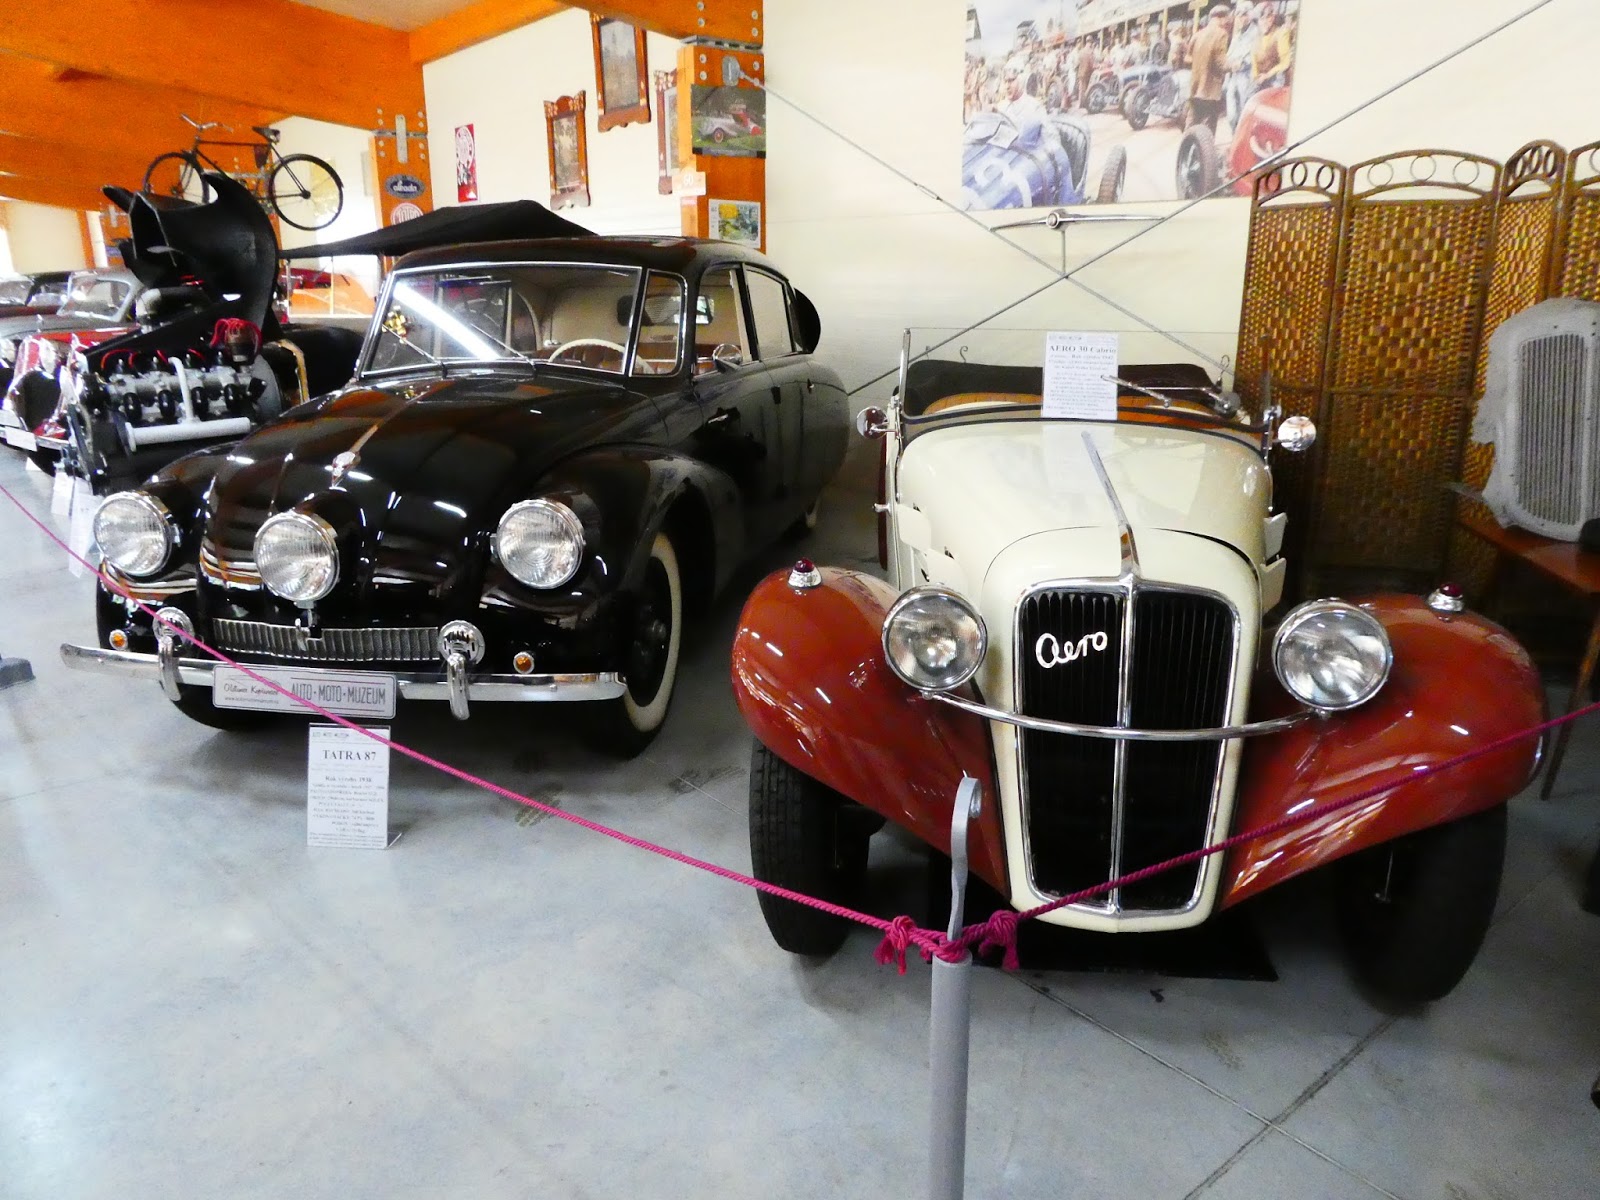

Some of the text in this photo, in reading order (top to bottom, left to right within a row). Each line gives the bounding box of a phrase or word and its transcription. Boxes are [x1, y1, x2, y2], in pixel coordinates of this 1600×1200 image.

[1090, 346, 1117, 354] Cabrio
[1035, 631, 1108, 669] Aero
[318, 685, 343, 703] MOTO
[348, 687, 387, 706] MUZEUM
[322, 749, 377, 761] TATRA 87
